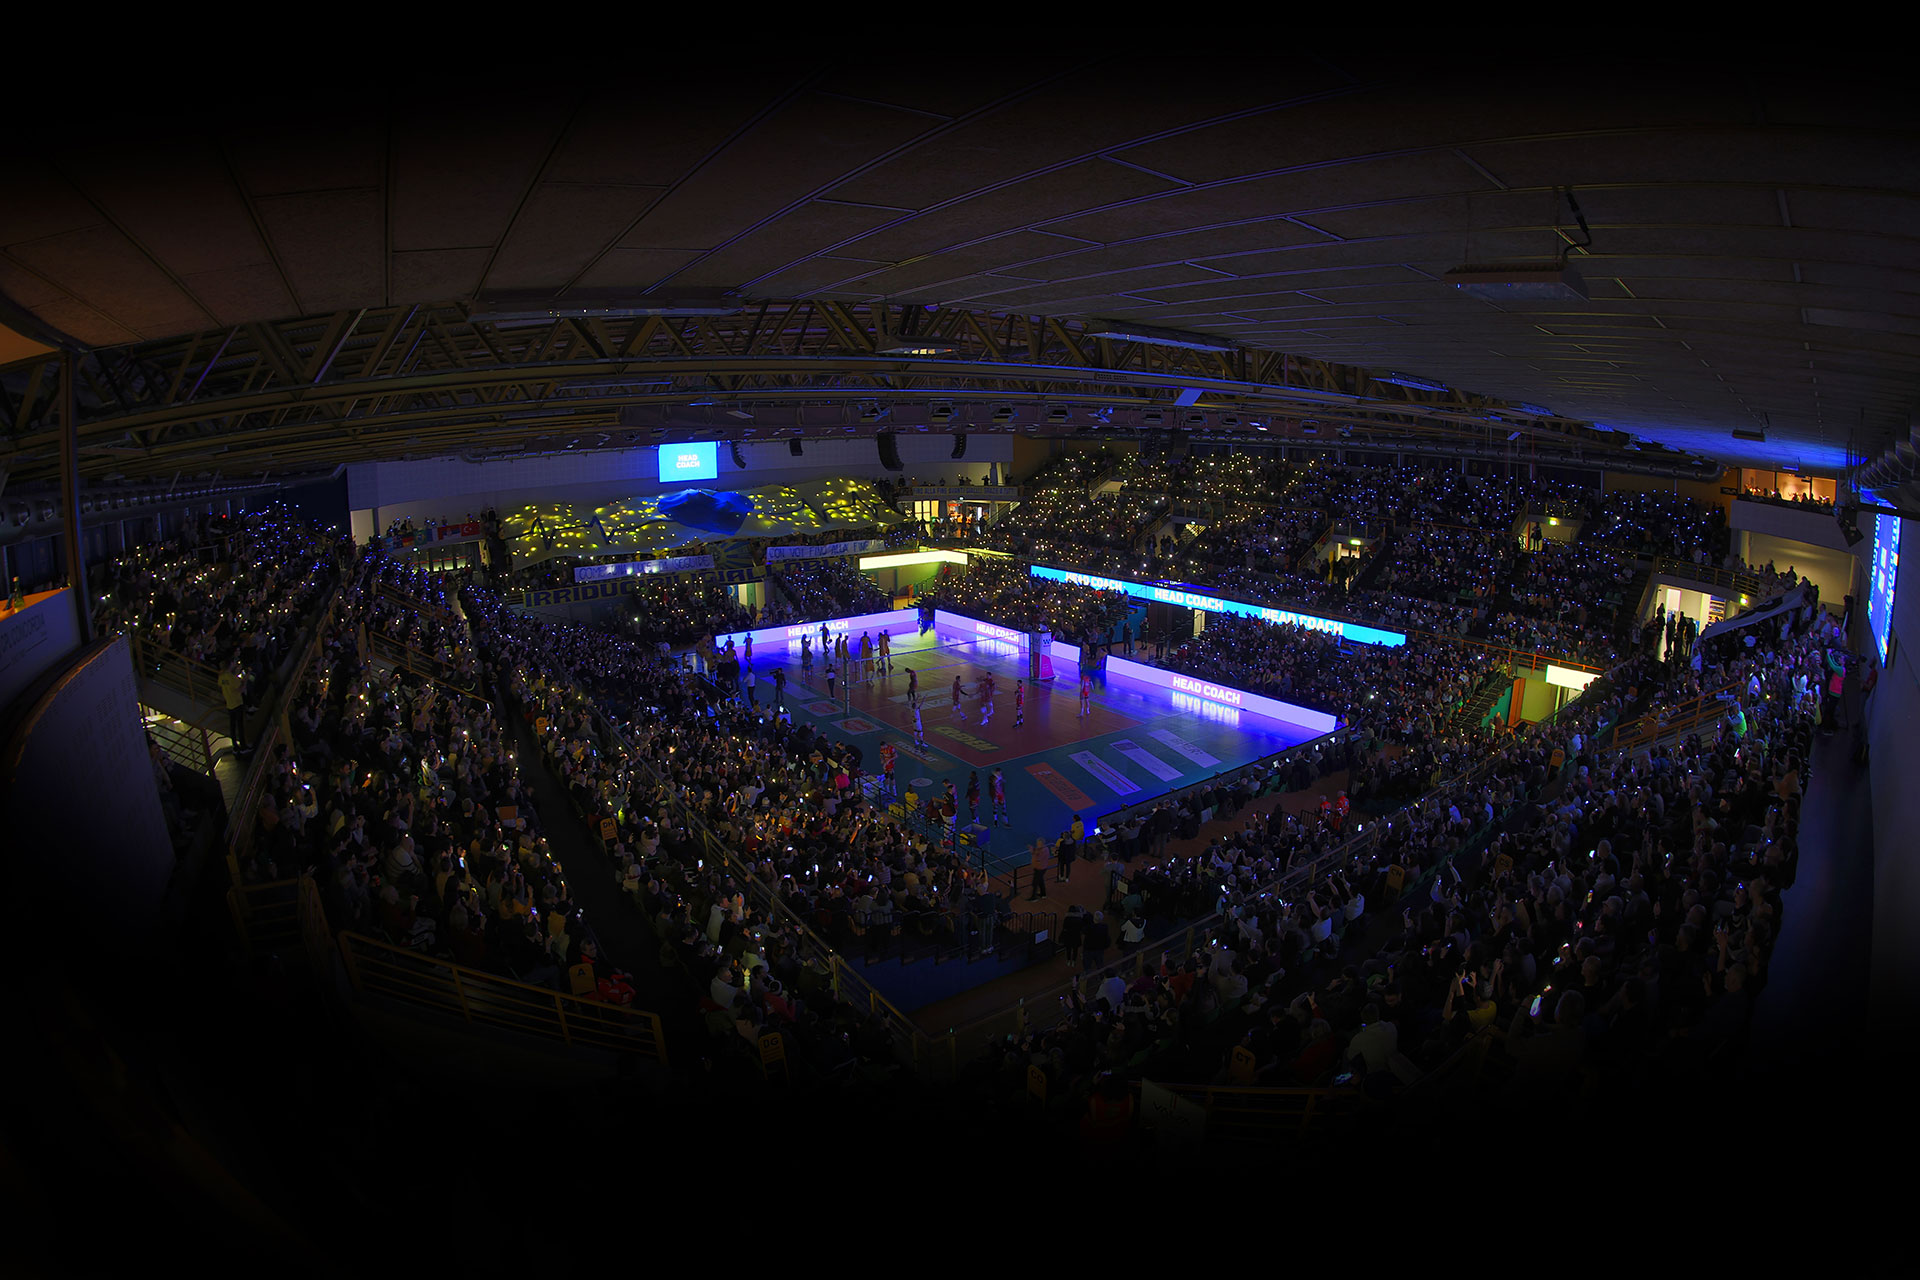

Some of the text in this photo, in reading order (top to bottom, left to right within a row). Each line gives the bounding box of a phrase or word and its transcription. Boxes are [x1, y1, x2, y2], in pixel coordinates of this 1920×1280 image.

[676, 460, 700, 468] COACH
[1065, 572, 1123, 591] HEAD COACH
[1154, 588, 1224, 611] HEAD COACH
[788, 626, 815, 636] HEAD
[1262, 608, 1344, 636] HEAD COACH
[976, 623, 1019, 642] HEAD COACH
[1172, 676, 1241, 705] HEAD COACH
